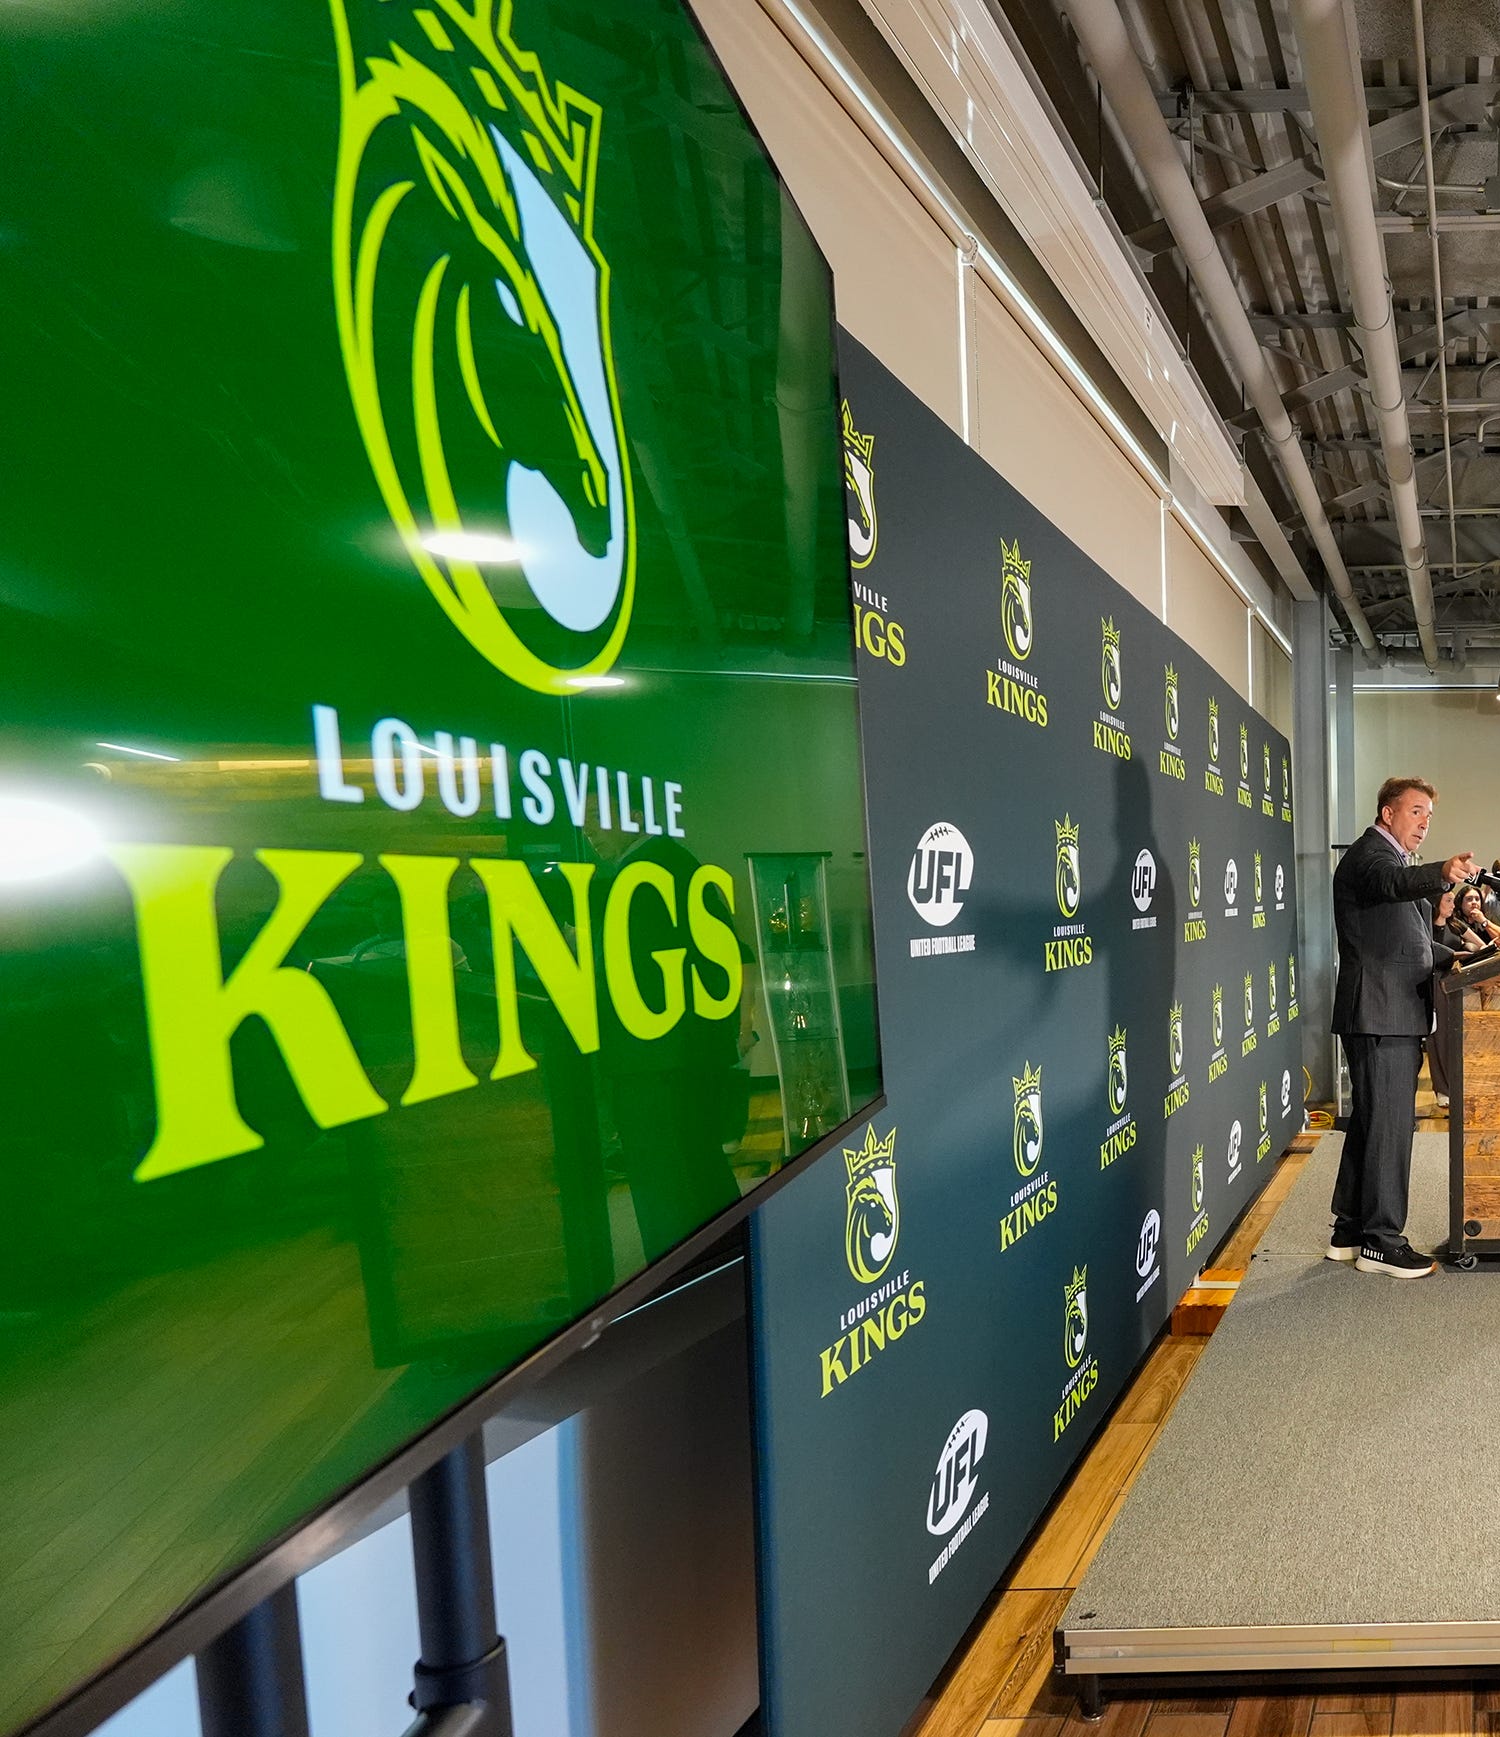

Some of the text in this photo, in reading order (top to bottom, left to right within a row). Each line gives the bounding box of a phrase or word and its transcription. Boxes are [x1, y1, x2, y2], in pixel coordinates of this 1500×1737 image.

[998, 658, 1039, 689] LOUISVILLE
[986, 669, 1048, 728] KINGS
[1093, 720, 1132, 761] KINGS
[311, 704, 686, 840] LOUISVILLE
[1159, 750, 1186, 781] KINGS
[912, 848, 970, 904] UFL
[1133, 865, 1153, 899] UFL
[1044, 936, 1093, 972] KINGS
[1053, 924, 1085, 937] LOUISVILLE
[103, 841, 744, 1184] KINGS
[1164, 1081, 1190, 1120] KINGS
[1099, 1120, 1137, 1171] KINGS
[1010, 1171, 1049, 1208] LOUISVILLE
[999, 1180, 1058, 1253] KINGS
[1186, 1212, 1209, 1258] KINGS
[839, 1269, 910, 1331] LOUISVILLE
[819, 1280, 927, 1400] KINGS
[1053, 1358, 1099, 1443] KINGS
[1061, 1353, 1093, 1400] LOUISVILLE
[931, 1426, 982, 1527] UFL
